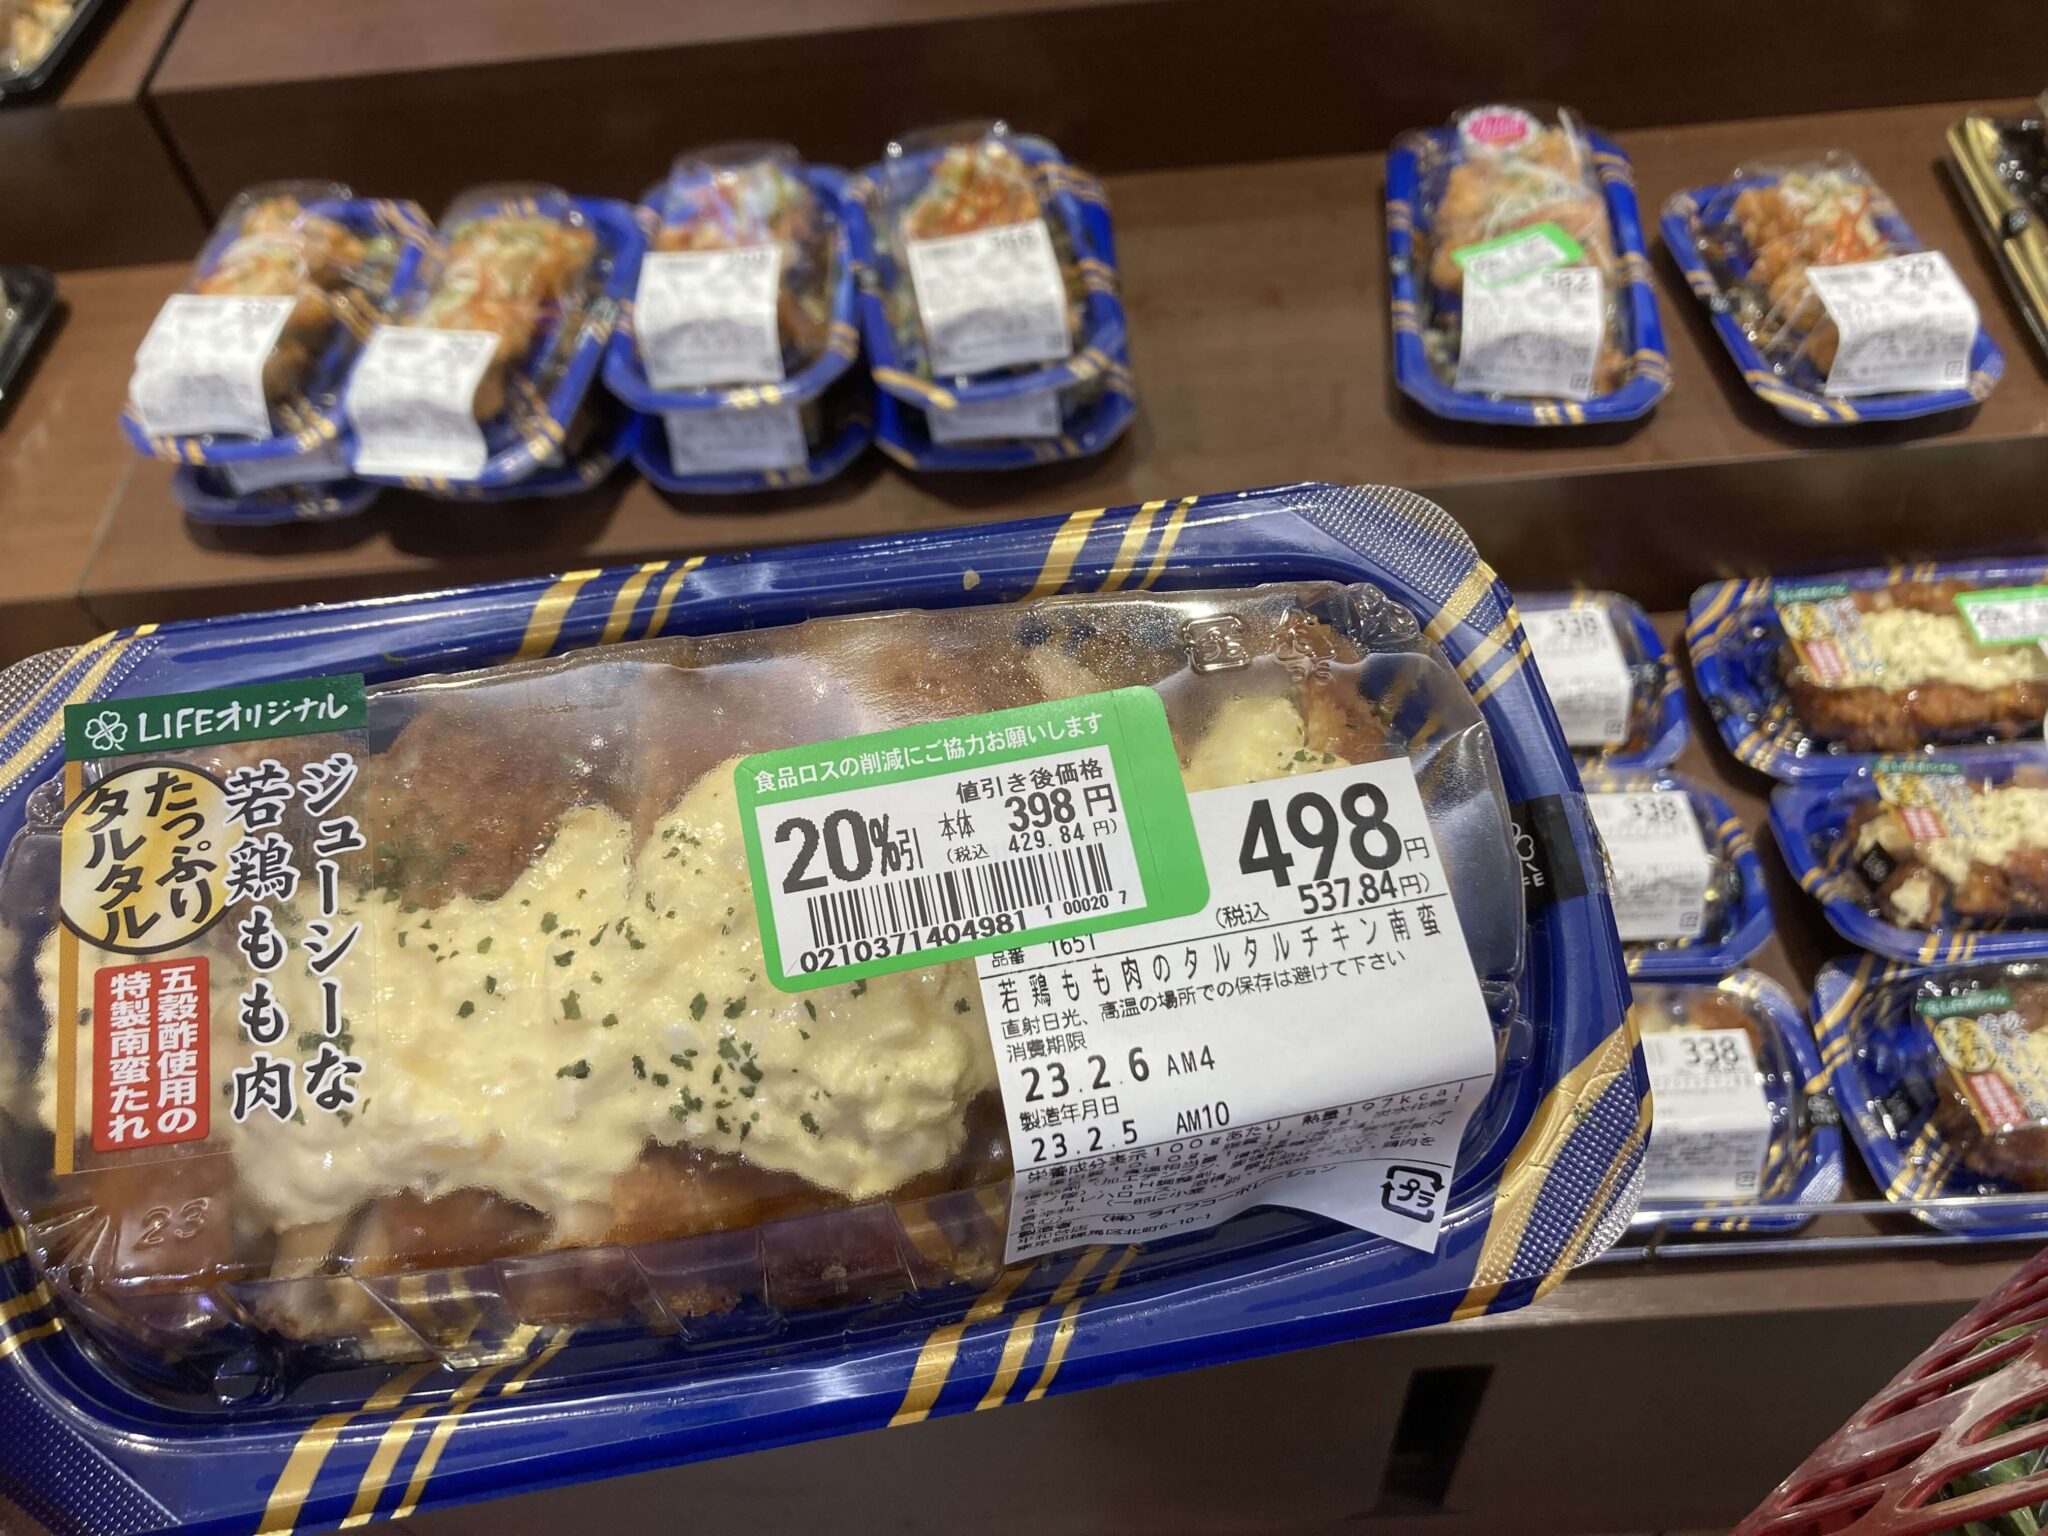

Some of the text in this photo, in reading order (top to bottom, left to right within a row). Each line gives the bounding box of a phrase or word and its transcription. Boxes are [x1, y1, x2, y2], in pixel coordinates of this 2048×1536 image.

[138, 692, 349, 743] LIFEオリジナル
[754, 711, 1103, 794] 食品ロスの削減にご協力お願いします
[956, 757, 1103, 803] 値引き後価格
[145, 770, 217, 923] たっぷり
[938, 809, 975, 841] 本体
[82, 787, 161, 944] タルタル
[226, 763, 296, 1120] 若鶏もも肉
[300, 756, 363, 1109] ジューシーな
[800, 911, 1027, 973] 0210371404981
[1063, 894, 1109, 916] 00020
[1119, 890, 1127, 905] 7
[999, 902, 1441, 1014] 若鶏もも肉のタルタルチキン南蛮
[1048, 934, 1096, 957] 1651
[108, 971, 151, 1143] 特製南蛮たれ
[156, 965, 199, 1134] 五穀酢使用の
[1006, 1031, 1088, 1063] 消費期限
[1167, 1045, 1216, 1076] AM4
[1681, 1036, 1738, 1064] 338
[1019, 1095, 1120, 1132] 製造年月日
[1176, 1102, 1230, 1134] AM10
